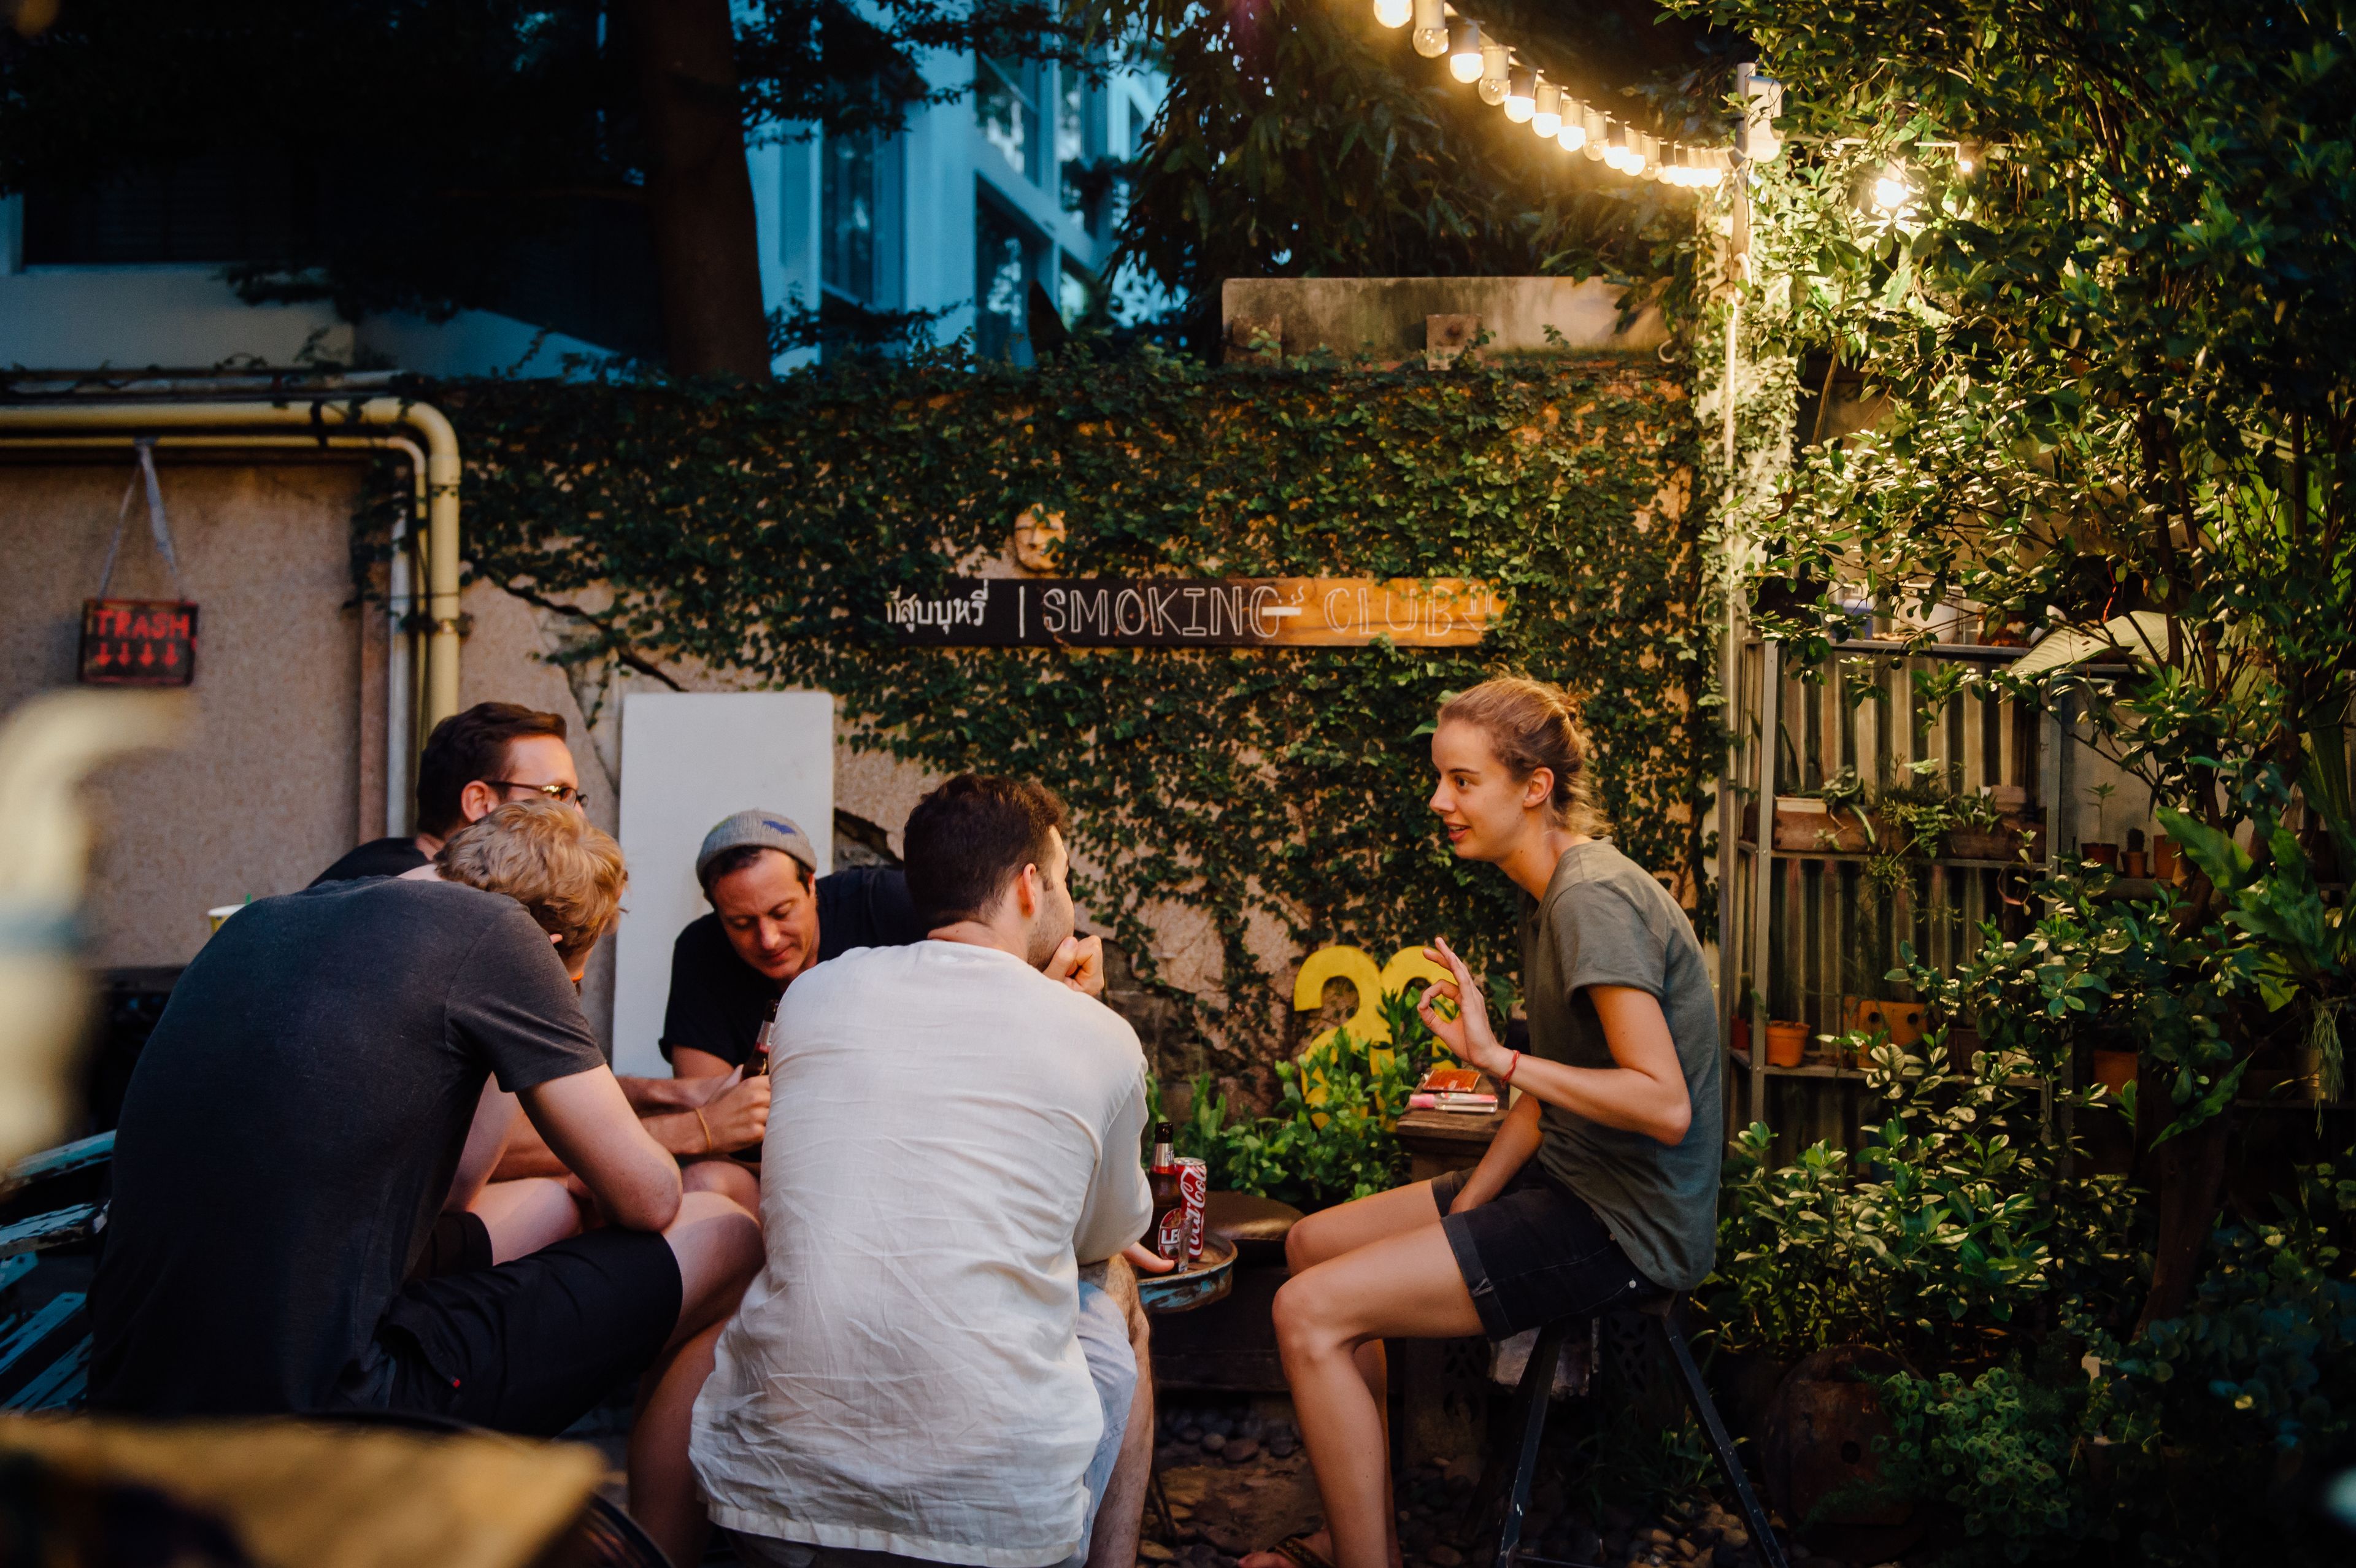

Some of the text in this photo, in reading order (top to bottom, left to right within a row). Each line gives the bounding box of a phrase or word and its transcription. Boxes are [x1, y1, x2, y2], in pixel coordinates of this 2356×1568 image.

[94, 609, 190, 639] TRASH
[1043, 585, 1301, 639] SMOKING
[1323, 586, 1453, 637] CLUB
[1161, 1229, 1178, 1244] LE
